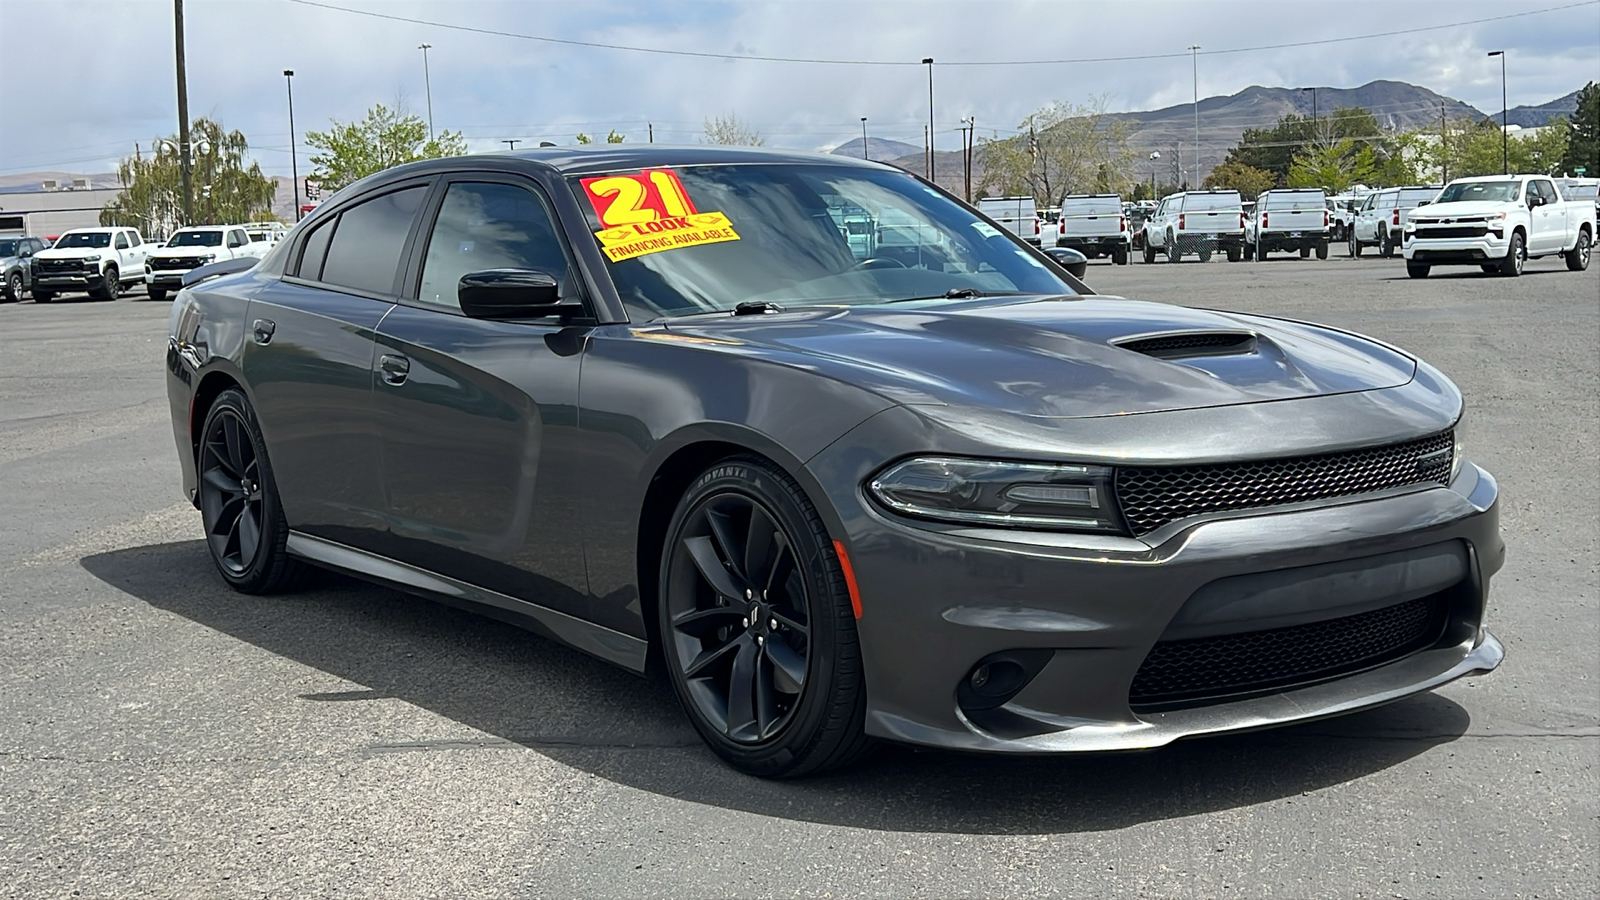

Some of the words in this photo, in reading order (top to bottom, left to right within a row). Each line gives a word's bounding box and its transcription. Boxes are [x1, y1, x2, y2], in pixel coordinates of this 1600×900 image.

[589, 171, 689, 225] 21
[633, 217, 693, 235] LOOK
[609, 237, 673, 258] FINANCING
[674, 228, 733, 244] AVAILABLE
[697, 466, 748, 487] ADVANTA
